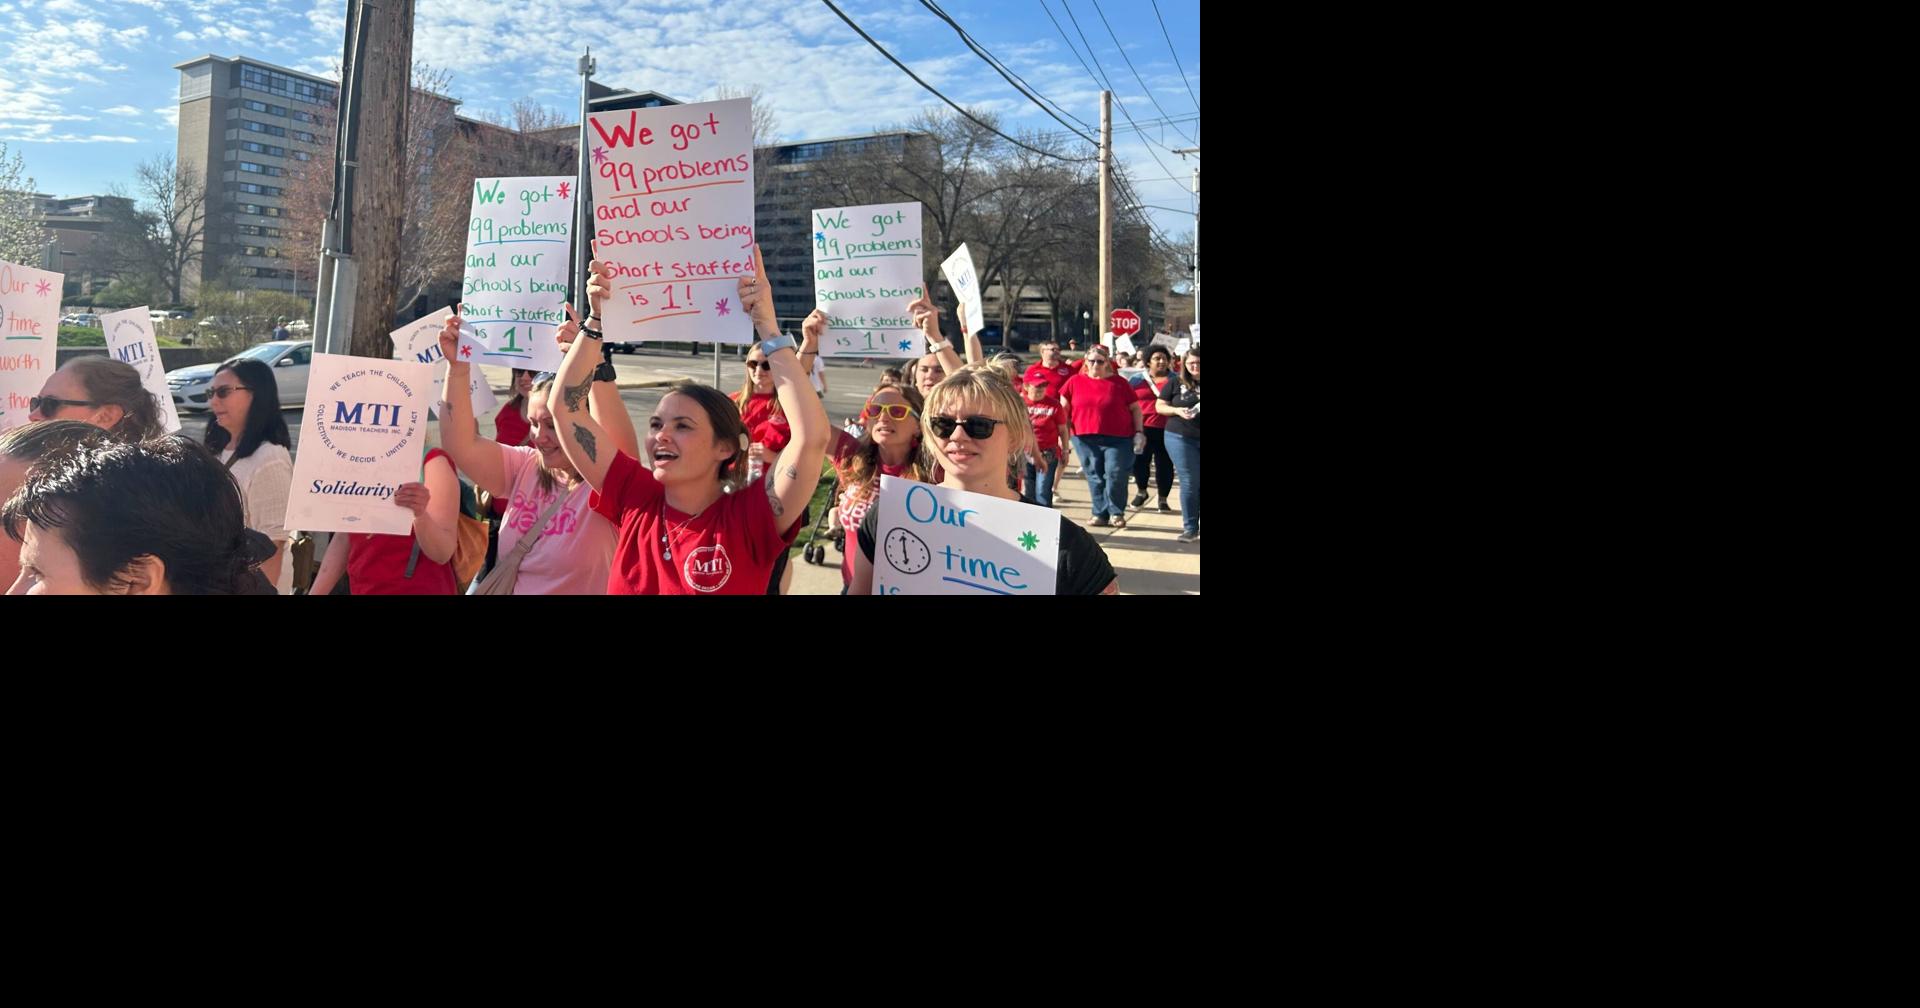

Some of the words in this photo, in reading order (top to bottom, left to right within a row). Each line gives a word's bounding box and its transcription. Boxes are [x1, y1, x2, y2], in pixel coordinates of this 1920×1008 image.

[590, 111, 653, 149] We
[670, 113, 719, 151] got
[600, 161, 637, 192] 99
[643, 154, 749, 194] problems
[476, 180, 505, 204] We
[519, 185, 554, 215] got
[597, 198, 641, 220] and
[651, 197, 691, 216] our
[470, 217, 493, 243] 99
[499, 219, 568, 244] problems
[816, 210, 851, 229] We
[871, 210, 906, 237] got
[698, 224, 753, 249] being
[816, 237, 840, 256] 99
[845, 238, 923, 259] problems
[466, 252, 496, 268] and
[511, 252, 544, 266] our
[0, 265, 29, 296] Our
[817, 267, 844, 280] and
[849, 266, 878, 277] our
[529, 279, 568, 304] being
[628, 291, 648, 306] is
[880, 286, 923, 299] being
[7, 311, 41, 335] time
[1110, 318, 1138, 329] STOP
[0, 354, 40, 371] worth
[118, 341, 145, 363] MTI
[416, 343, 443, 364] MT
[329, 381, 341, 392] WE
[342, 370, 366, 382] TEACH
[370, 369, 384, 377] THE
[386, 373, 413, 398] CHILDREN
[333, 400, 403, 427] MTI
[316, 404, 336, 450] COLLECTIVELY
[336, 449, 347, 459] WE
[350, 455, 376, 463] DECIDE
[385, 438, 408, 458] UNITED
[407, 427, 417, 437] WE
[906, 485, 979, 528] Our
[692, 558, 723, 573] MTI
[936, 544, 1028, 589] time
